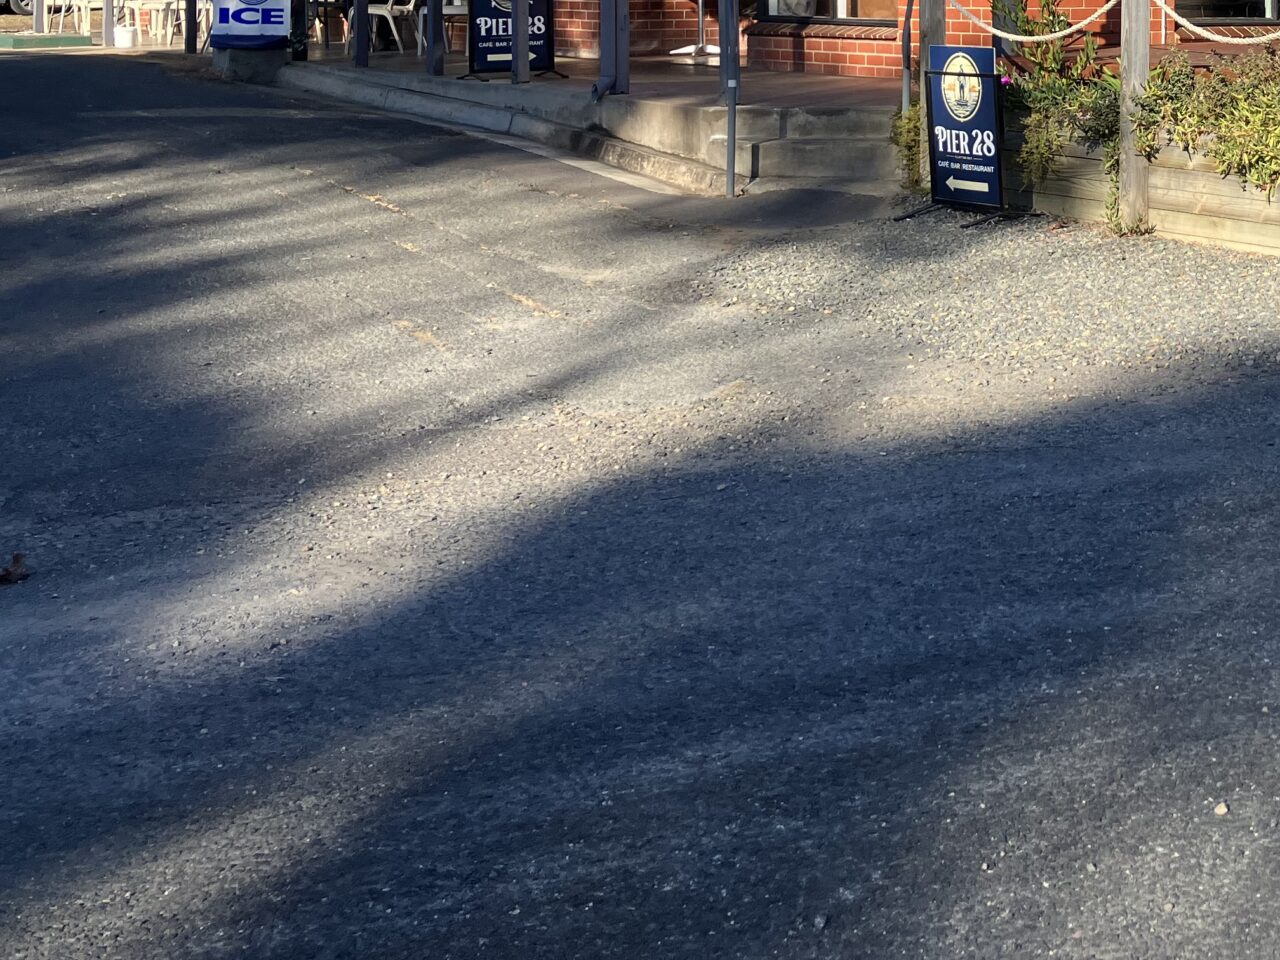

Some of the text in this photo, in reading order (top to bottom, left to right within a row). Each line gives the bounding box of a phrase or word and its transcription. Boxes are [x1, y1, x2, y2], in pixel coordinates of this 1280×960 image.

[219, 8, 284, 25] ICE
[935, 126, 995, 156] PIER 28
[962, 164, 995, 173] RESTAURANT
